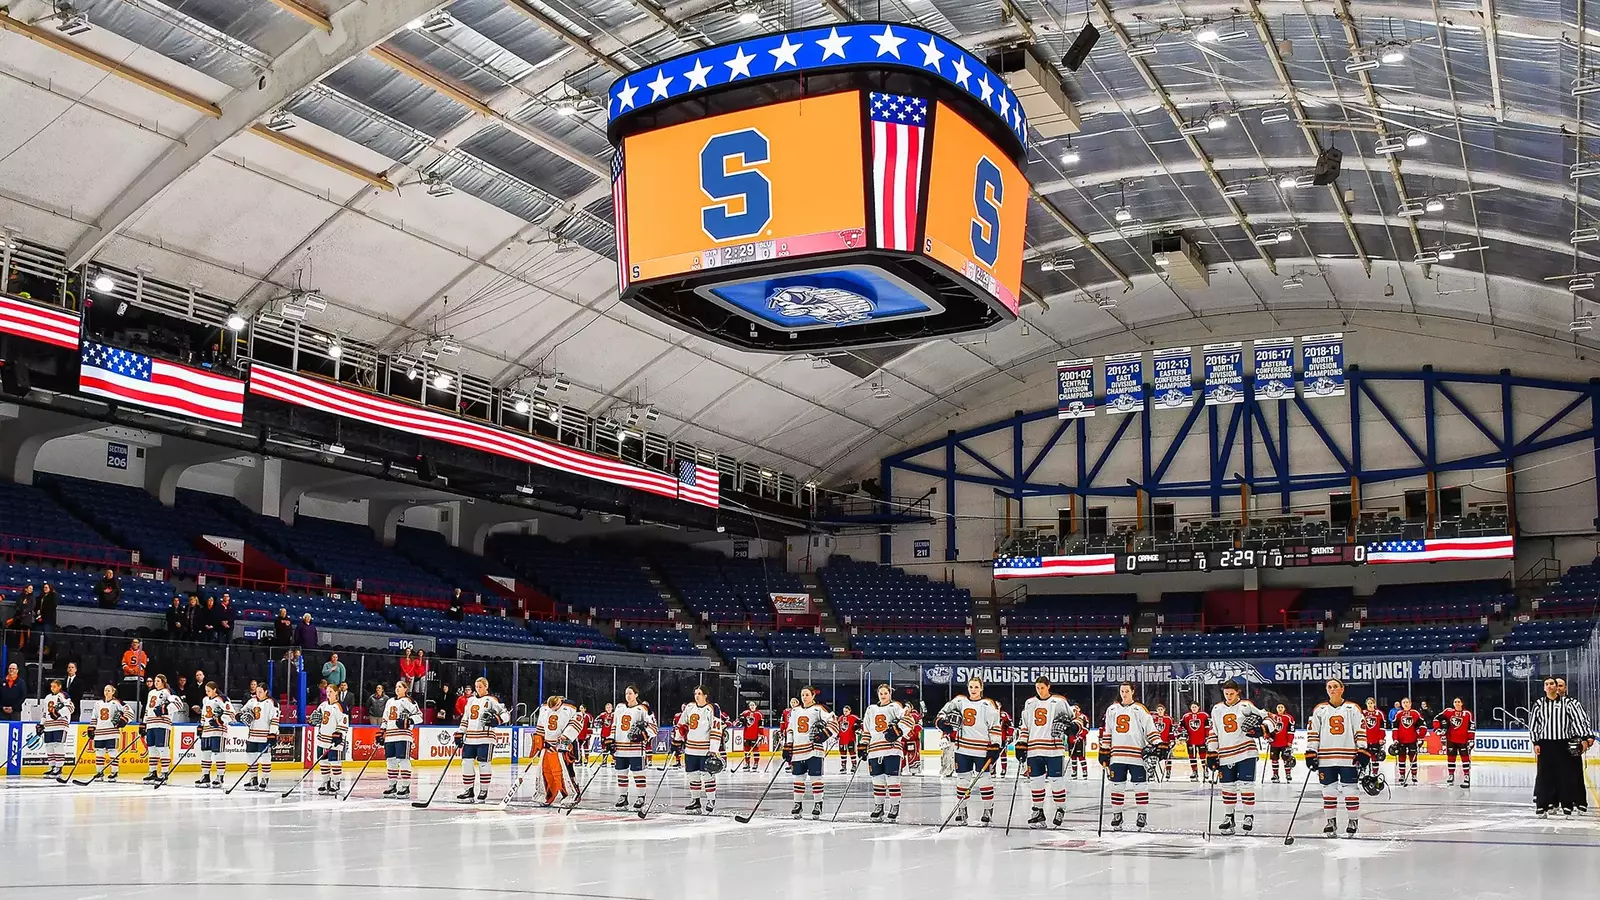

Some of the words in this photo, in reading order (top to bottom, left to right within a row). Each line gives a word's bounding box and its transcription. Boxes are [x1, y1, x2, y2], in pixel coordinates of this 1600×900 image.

[698, 126, 771, 243] S
[969, 154, 1004, 268] S
[925, 239, 932, 252] S
[725, 244, 754, 259] 2:29
[763, 249, 770, 260] 0
[708, 257, 715, 267] 0
[632, 265, 641, 279] S
[1256, 349, 1292, 361] 2016-17
[1304, 345, 1340, 357] 2018-19
[1155, 359, 1189, 371] 2012-13
[1205, 354, 1240, 366] 2016-17
[1261, 360, 1287, 368] EASTERN
[1311, 356, 1334, 364] NORTH
[1107, 363, 1140, 376] 2012-13
[1212, 364, 1234, 372] NORTH
[1255, 366, 1293, 374] CONFERENCE
[1309, 362, 1337, 370] DIVISION
[1060, 369, 1092, 381] 2001-02
[1155, 374, 1191, 383] CONFERENCE
[1209, 370, 1237, 379] DIVISION
[1257, 372, 1291, 380] CHAMPIONS
[1304, 368, 1343, 378] CHAMPIONS
[1062, 380, 1090, 388] CENTRAL
[1111, 380, 1137, 388] DIVISION
[1155, 381, 1191, 390] CHAMPIONS
[1205, 376, 1242, 386] CHAMPIONS
[1106, 385, 1141, 395] CHAMPIONS
[1059, 391, 1093, 401] CHAMPIONS
[109, 445, 127, 454] SECTION
[108, 456, 127, 467] 206
[916, 549, 928, 557] 211
[1311, 547, 1334, 555] SAINTS
[1354, 545, 1365, 561] 0
[1126, 555, 1136, 571] 0
[1137, 554, 1159, 562] ORANGE
[1220, 550, 1254, 567] 2:29
[1275, 555, 1282, 566] 0
[1199, 559, 1206, 569] 0
[256, 629, 274, 640] 105
[399, 639, 414, 650] 106
[130, 656, 137, 665] S
[585, 654, 596, 664] 107
[956, 666, 1029, 683] SYRACUSE
[1030, 665, 1088, 683] CRUNCH
[1093, 664, 1172, 683] #OURTIME
[1274, 662, 1350, 682] SYRACUSE
[1352, 660, 1413, 680] CRUNCH
[1418, 658, 1501, 679] #OURTIME
[470, 705, 480, 720] S
[962, 707, 977, 727] S
[1034, 707, 1048, 727] S
[547, 714, 559, 731] S
[620, 714, 632, 732] S
[689, 713, 700, 730] S
[797, 715, 809, 733] S
[874, 714, 887, 733] S
[1115, 714, 1131, 734] S
[1222, 713, 1238, 733] S
[1329, 715, 1345, 735] S
[1476, 739, 1501, 749] BUD
[1501, 739, 1530, 750] LIGHT
[503, 783, 518, 804] CCM
